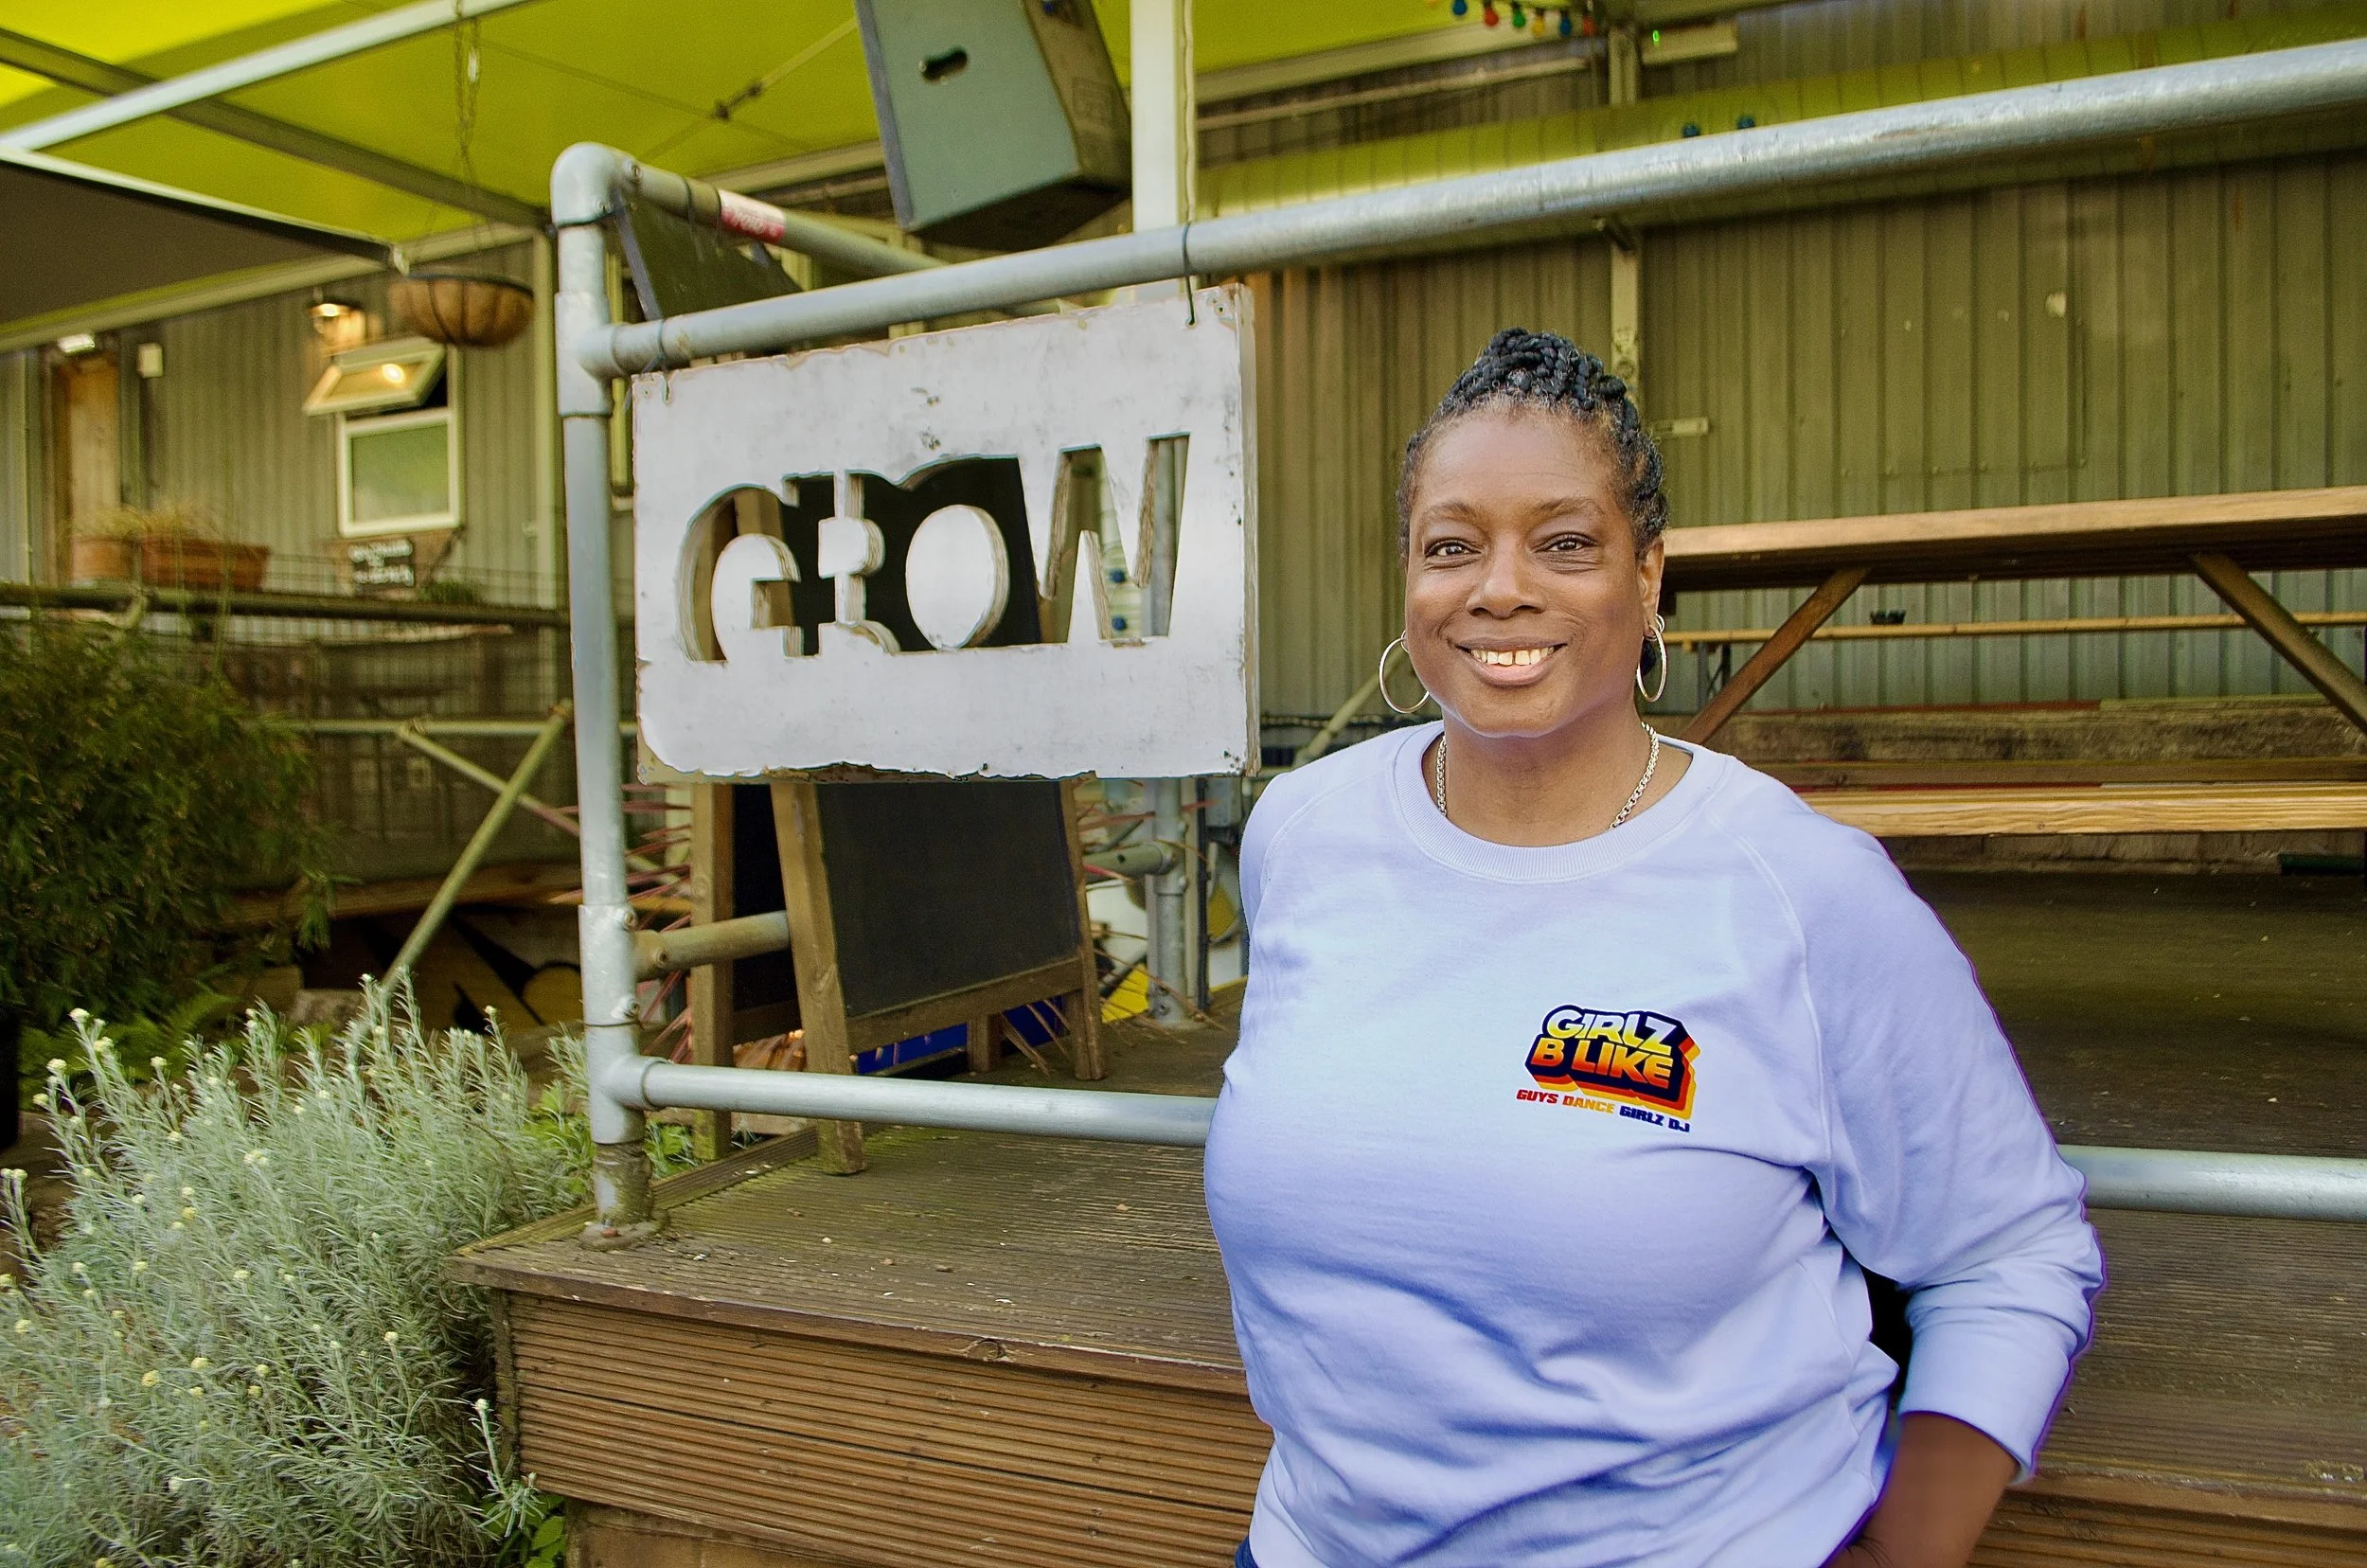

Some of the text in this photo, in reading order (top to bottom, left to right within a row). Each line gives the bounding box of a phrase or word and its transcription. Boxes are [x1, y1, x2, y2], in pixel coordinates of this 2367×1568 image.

[676, 432, 1190, 662] GROW
[1547, 1009, 1677, 1056] GIRLZ
[1530, 1039, 1673, 1089] B LIKE
[1516, 1090, 1691, 1132] GUYS DANCE GIRLZ DJ
